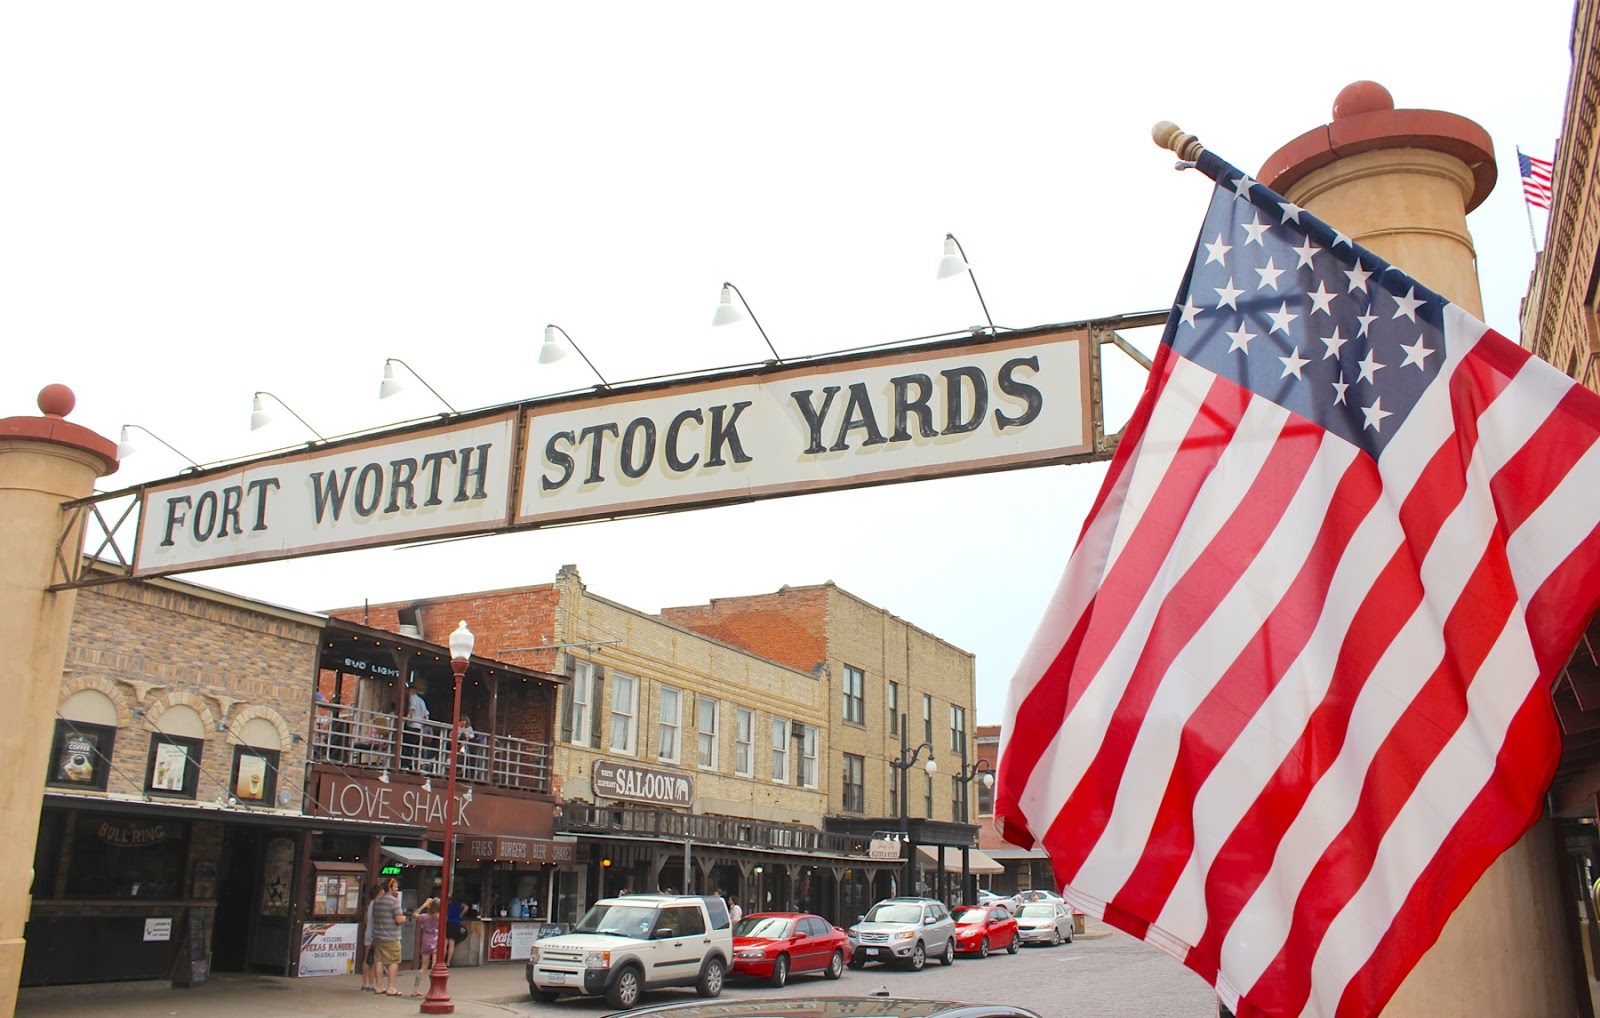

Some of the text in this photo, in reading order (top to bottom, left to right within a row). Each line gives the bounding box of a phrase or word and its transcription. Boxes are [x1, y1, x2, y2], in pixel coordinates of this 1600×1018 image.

[160, 355, 1044, 546] FORT WORTH STOCK YARDS
[345, 658, 400, 677] BUD LIGHT
[68, 743, 90, 752] COFFEE
[601, 769, 614, 777] WHITE
[597, 779, 616, 788] ELEPHANT
[616, 768, 675, 799] SALOON
[329, 782, 470, 826] LOVE SHACK
[98, 822, 165, 844] BULL RING
[471, 841, 572, 861] FRIES BURGERS BEER SHAKES
[305, 943, 356, 952] TEXAS RANGERS
